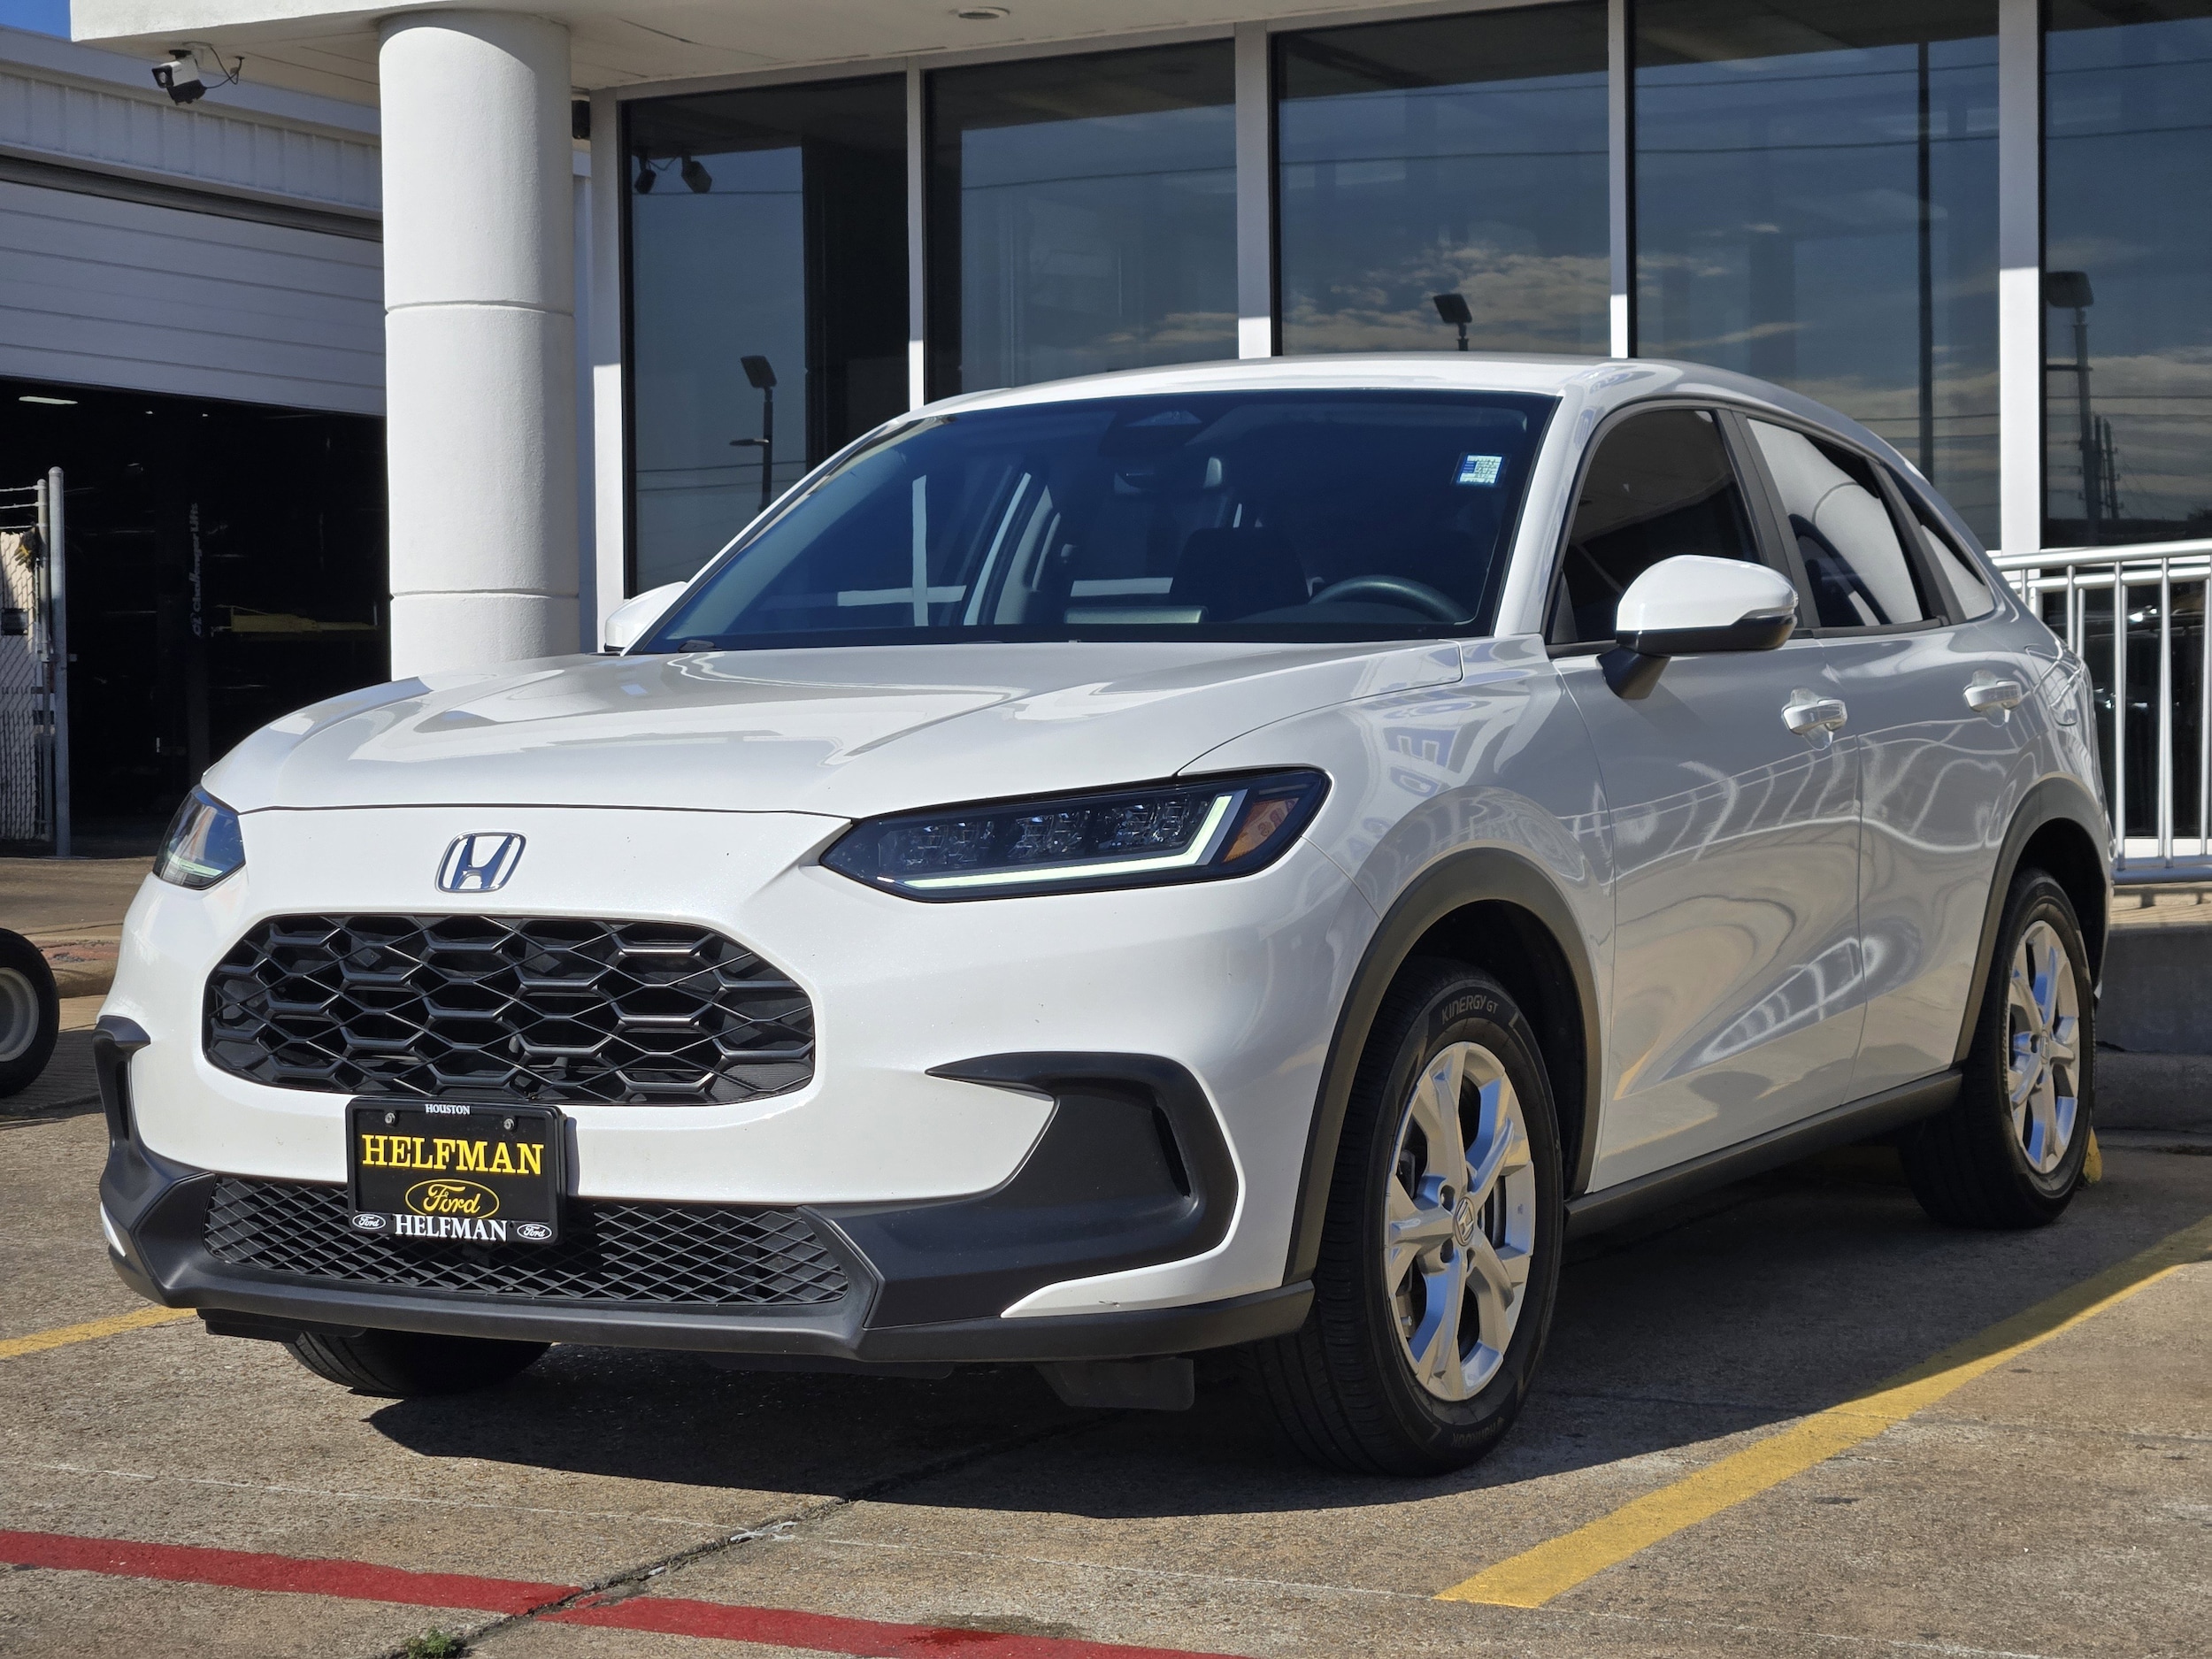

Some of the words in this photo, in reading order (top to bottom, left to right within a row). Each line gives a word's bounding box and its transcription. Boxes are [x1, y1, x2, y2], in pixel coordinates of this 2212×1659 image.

[1486, 1000, 1499, 1014] GT
[425, 1103, 471, 1115] HOUSTON
[361, 1134, 544, 1175] HELFMAN
[422, 1183, 481, 1214] Ford
[358, 1215, 380, 1228] Ford
[392, 1213, 509, 1242] HELFMAN
[523, 1225, 546, 1238] Ford
